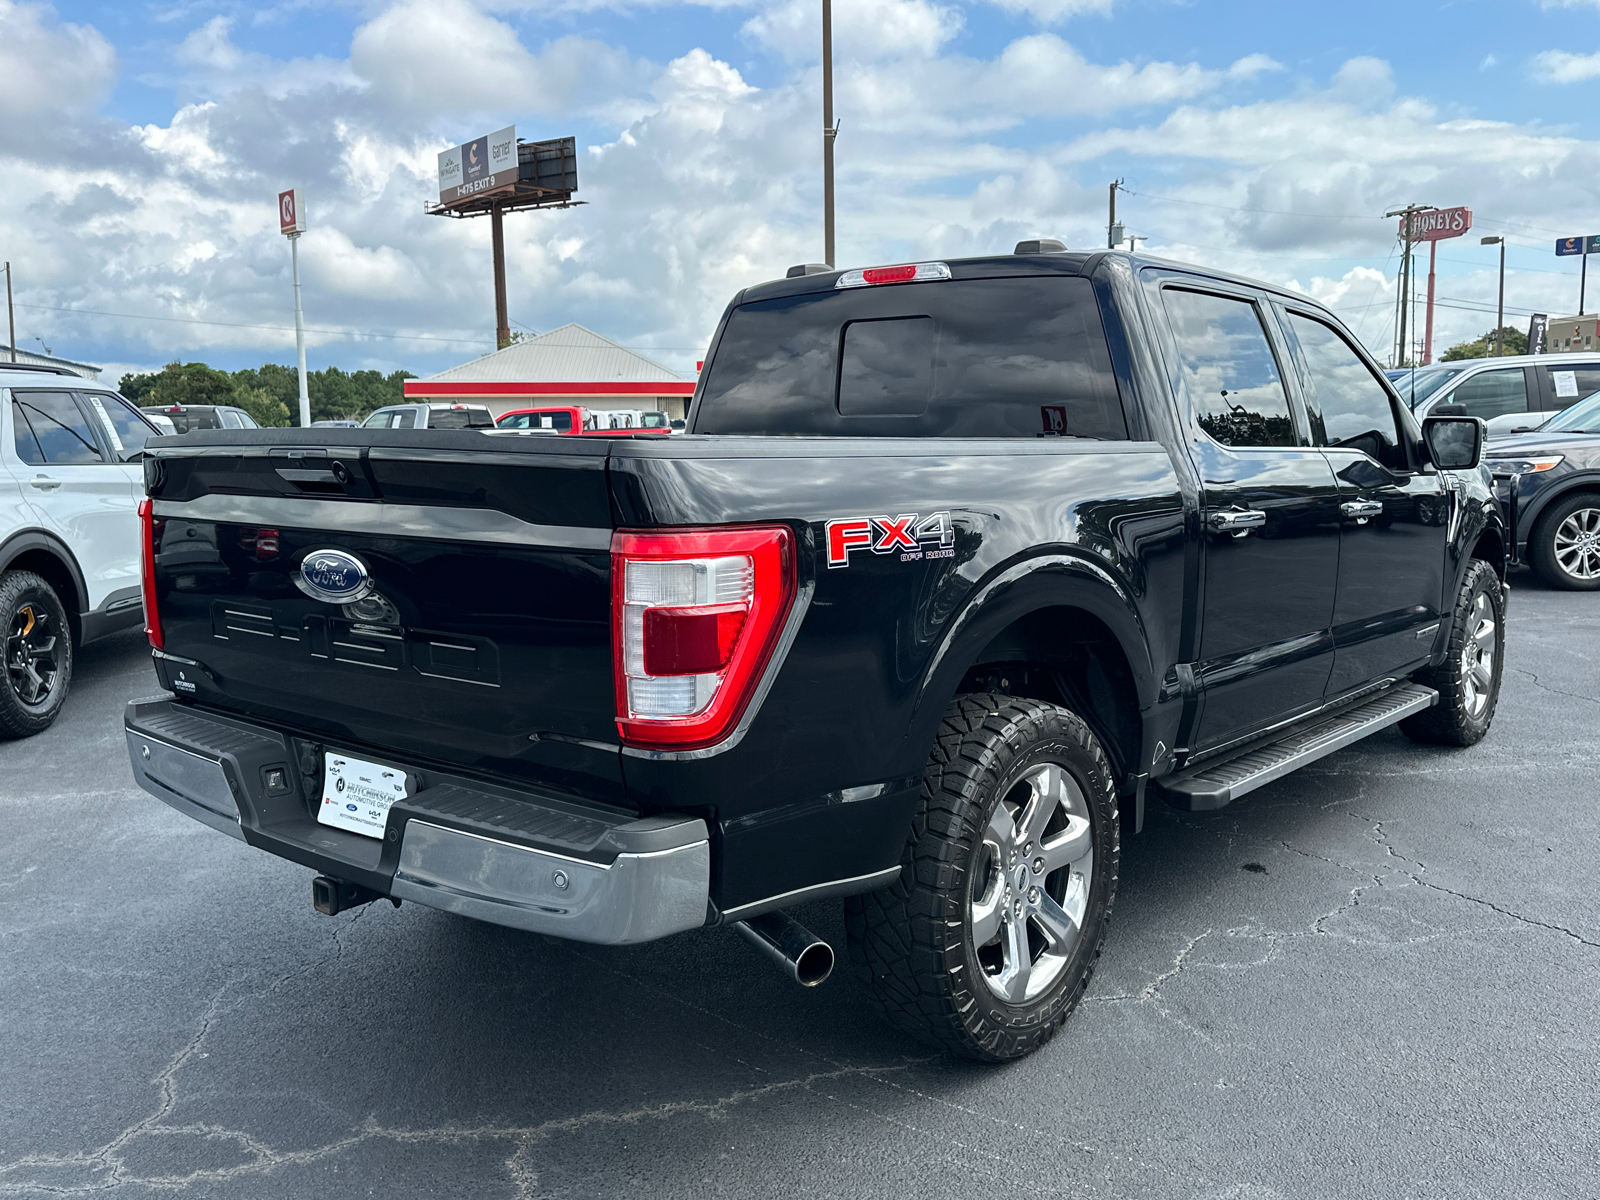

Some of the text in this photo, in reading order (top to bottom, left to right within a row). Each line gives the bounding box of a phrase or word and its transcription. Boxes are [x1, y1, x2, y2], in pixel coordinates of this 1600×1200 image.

[493, 141, 510, 158] Garner
[440, 164, 459, 176] WINGATE
[457, 175, 496, 196] I-475 EXIT 9
[824, 510, 955, 569] FX4
[901, 549, 955, 562] OFF ROAD
[312, 559, 348, 587] Ford
[209, 600, 500, 688] F-150
[346, 782, 396, 804] HUTCHINSON
[346, 794, 376, 807] AUTOMOTIVE
[376, 801, 391, 811] GROU
